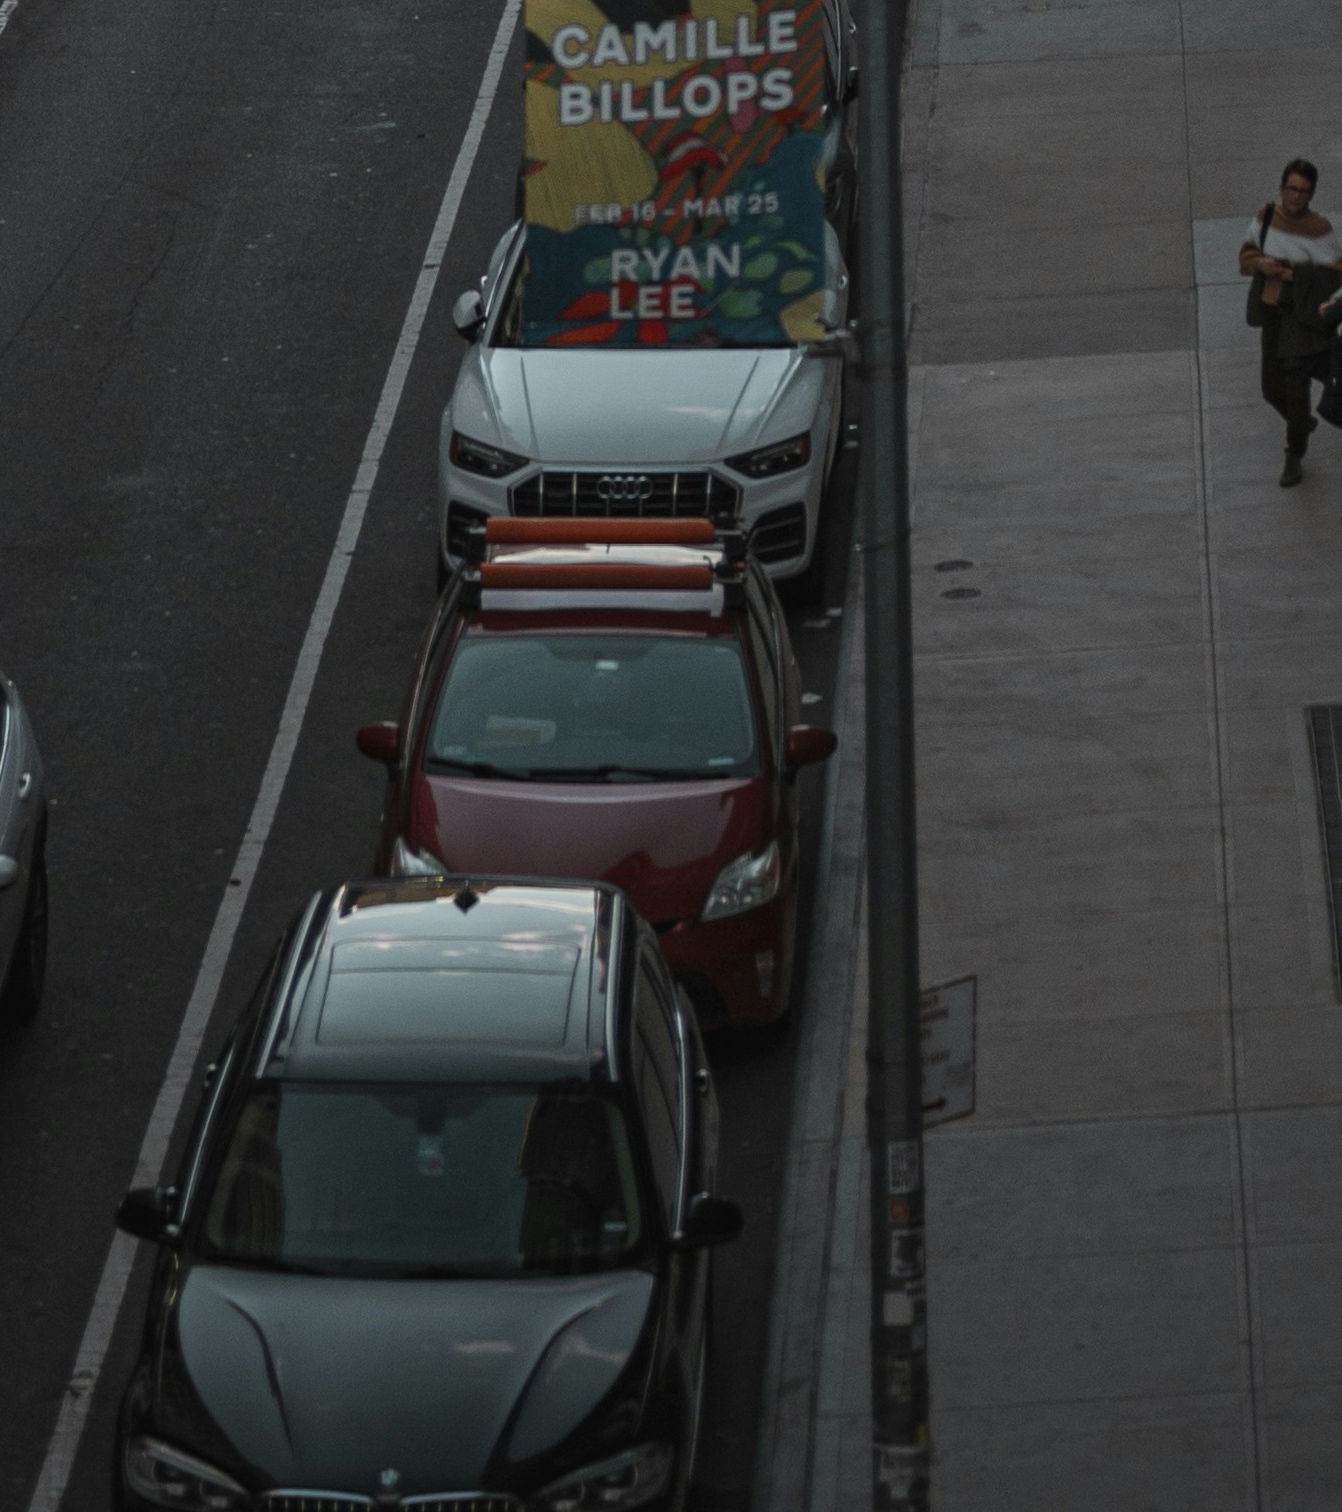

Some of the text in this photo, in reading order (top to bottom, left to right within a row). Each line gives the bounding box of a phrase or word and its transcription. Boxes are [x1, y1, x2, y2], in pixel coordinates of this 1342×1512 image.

[551, 9, 798, 71] CAMILLE
[560, 66, 795, 127] BILLOPS
[573, 202, 623, 225] FEB
[630, 201, 656, 223] 16
[681, 195, 742, 220] MAR
[746, 191, 780, 216] 25
[611, 244, 741, 283] RYAN
[609, 285, 696, 321] LEE
